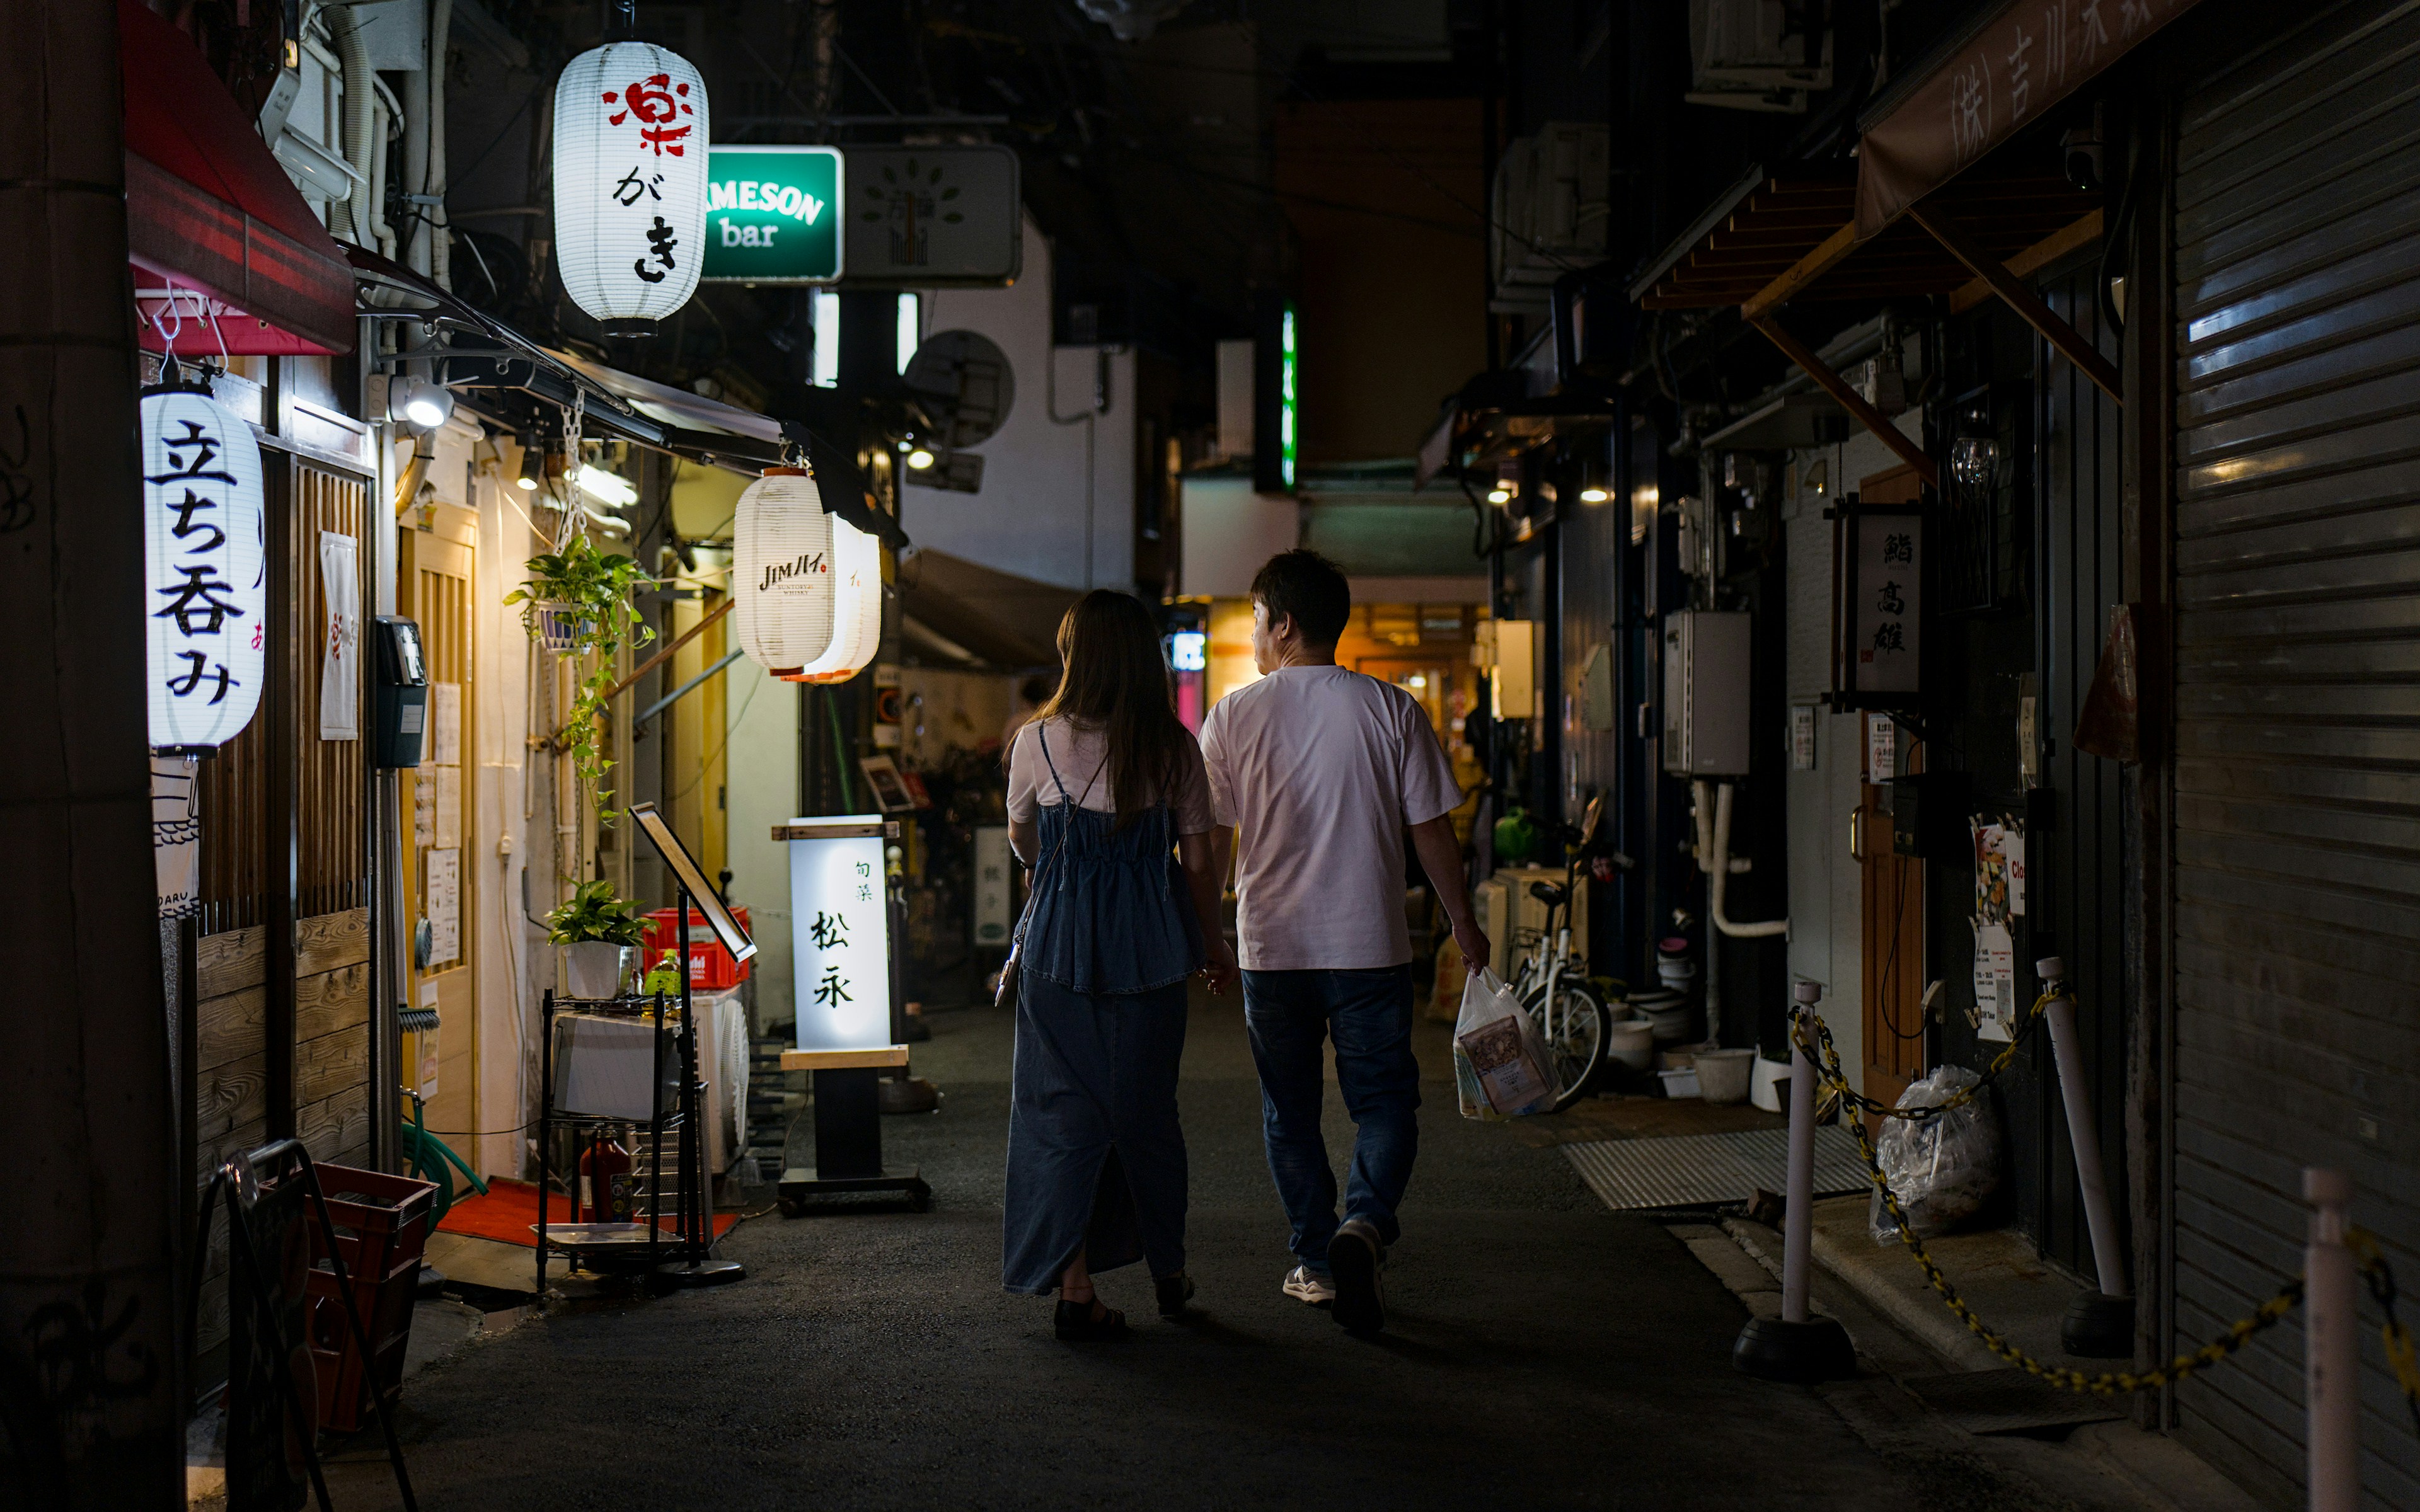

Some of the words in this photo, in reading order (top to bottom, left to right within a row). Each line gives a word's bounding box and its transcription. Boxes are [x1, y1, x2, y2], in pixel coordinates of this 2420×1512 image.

[601, 74, 693, 283] 楽がき
[718, 217, 779, 248] bar
[144, 420, 245, 705] 立ち呑み
[856, 861, 872, 901] 旬菜
[811, 912, 853, 1008] 松永
